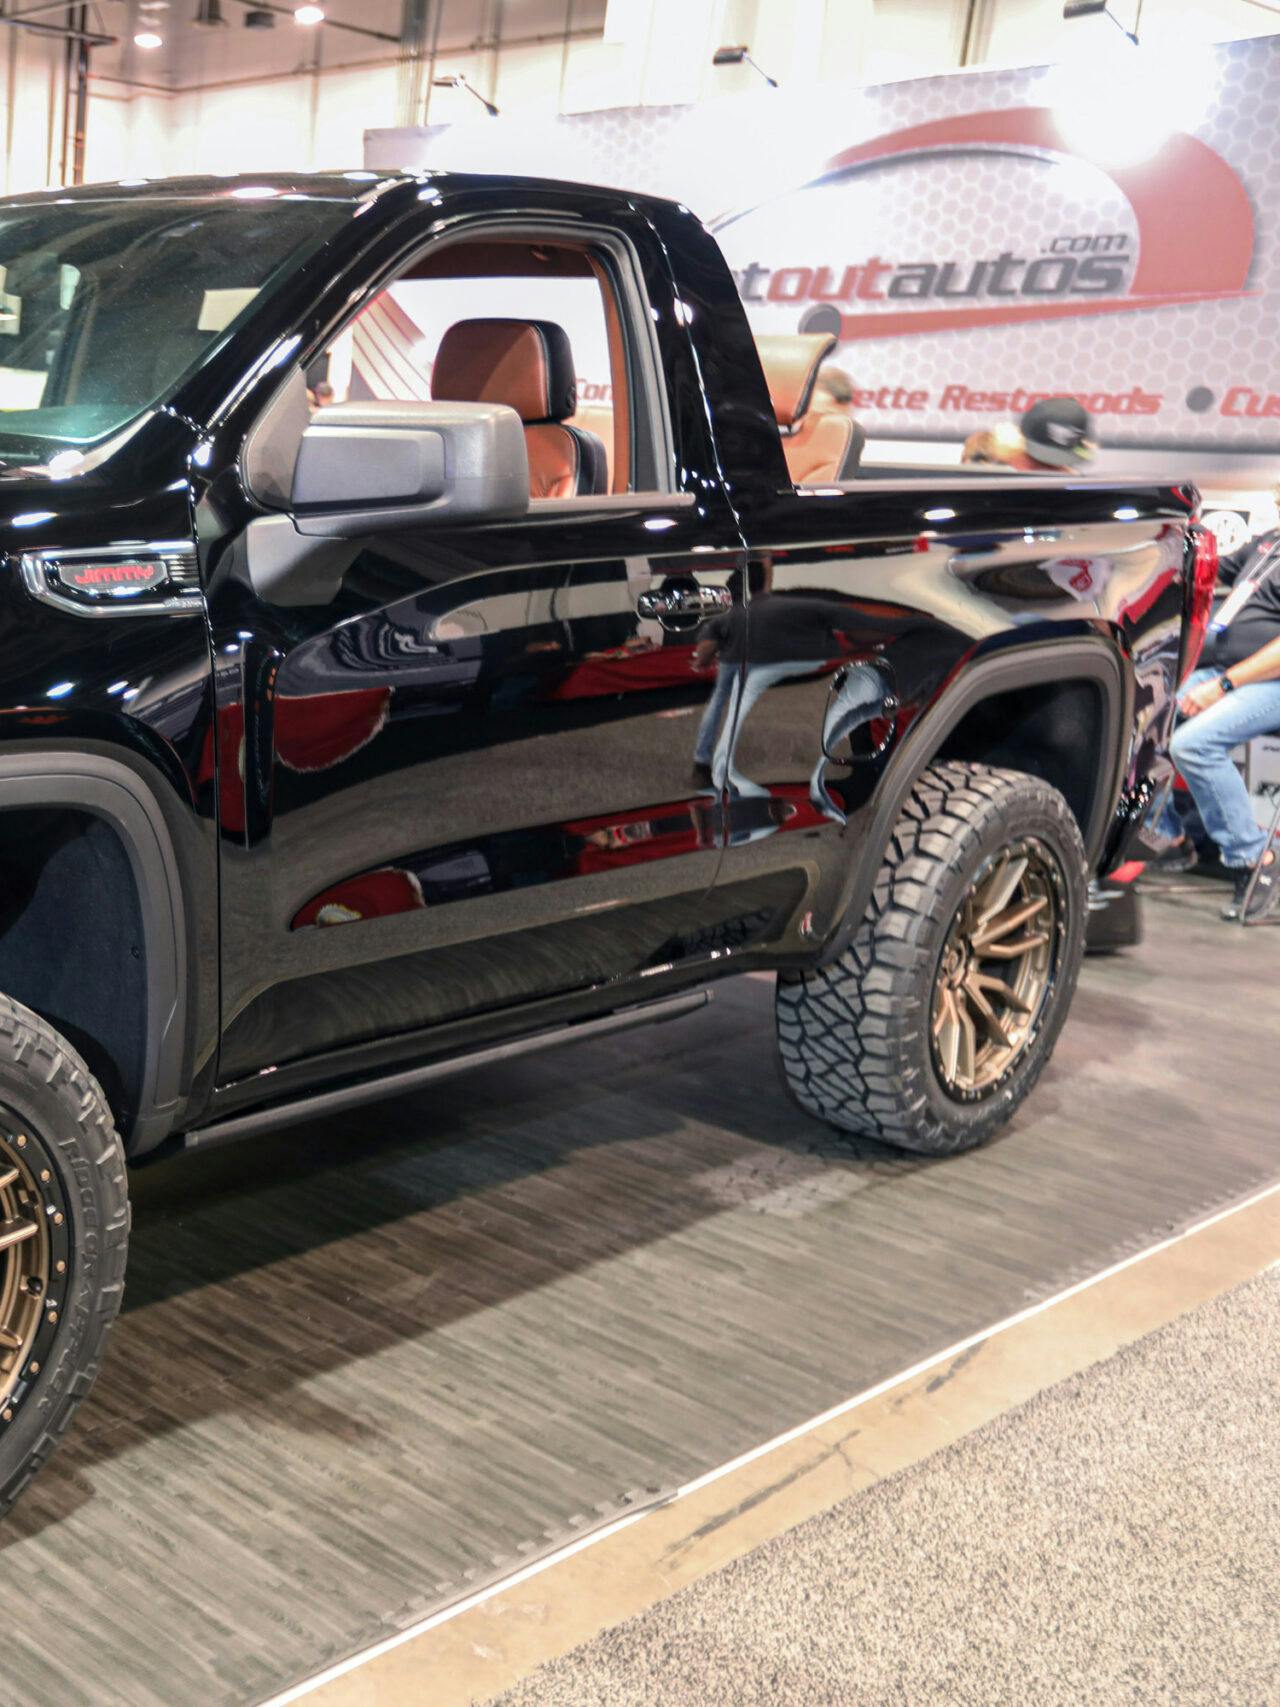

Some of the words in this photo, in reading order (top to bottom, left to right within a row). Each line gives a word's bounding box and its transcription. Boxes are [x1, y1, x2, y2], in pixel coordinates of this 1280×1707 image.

[736, 252, 1130, 303] toutautos
[851, 386, 930, 410] ette
[938, 384, 1164, 416] Restods
